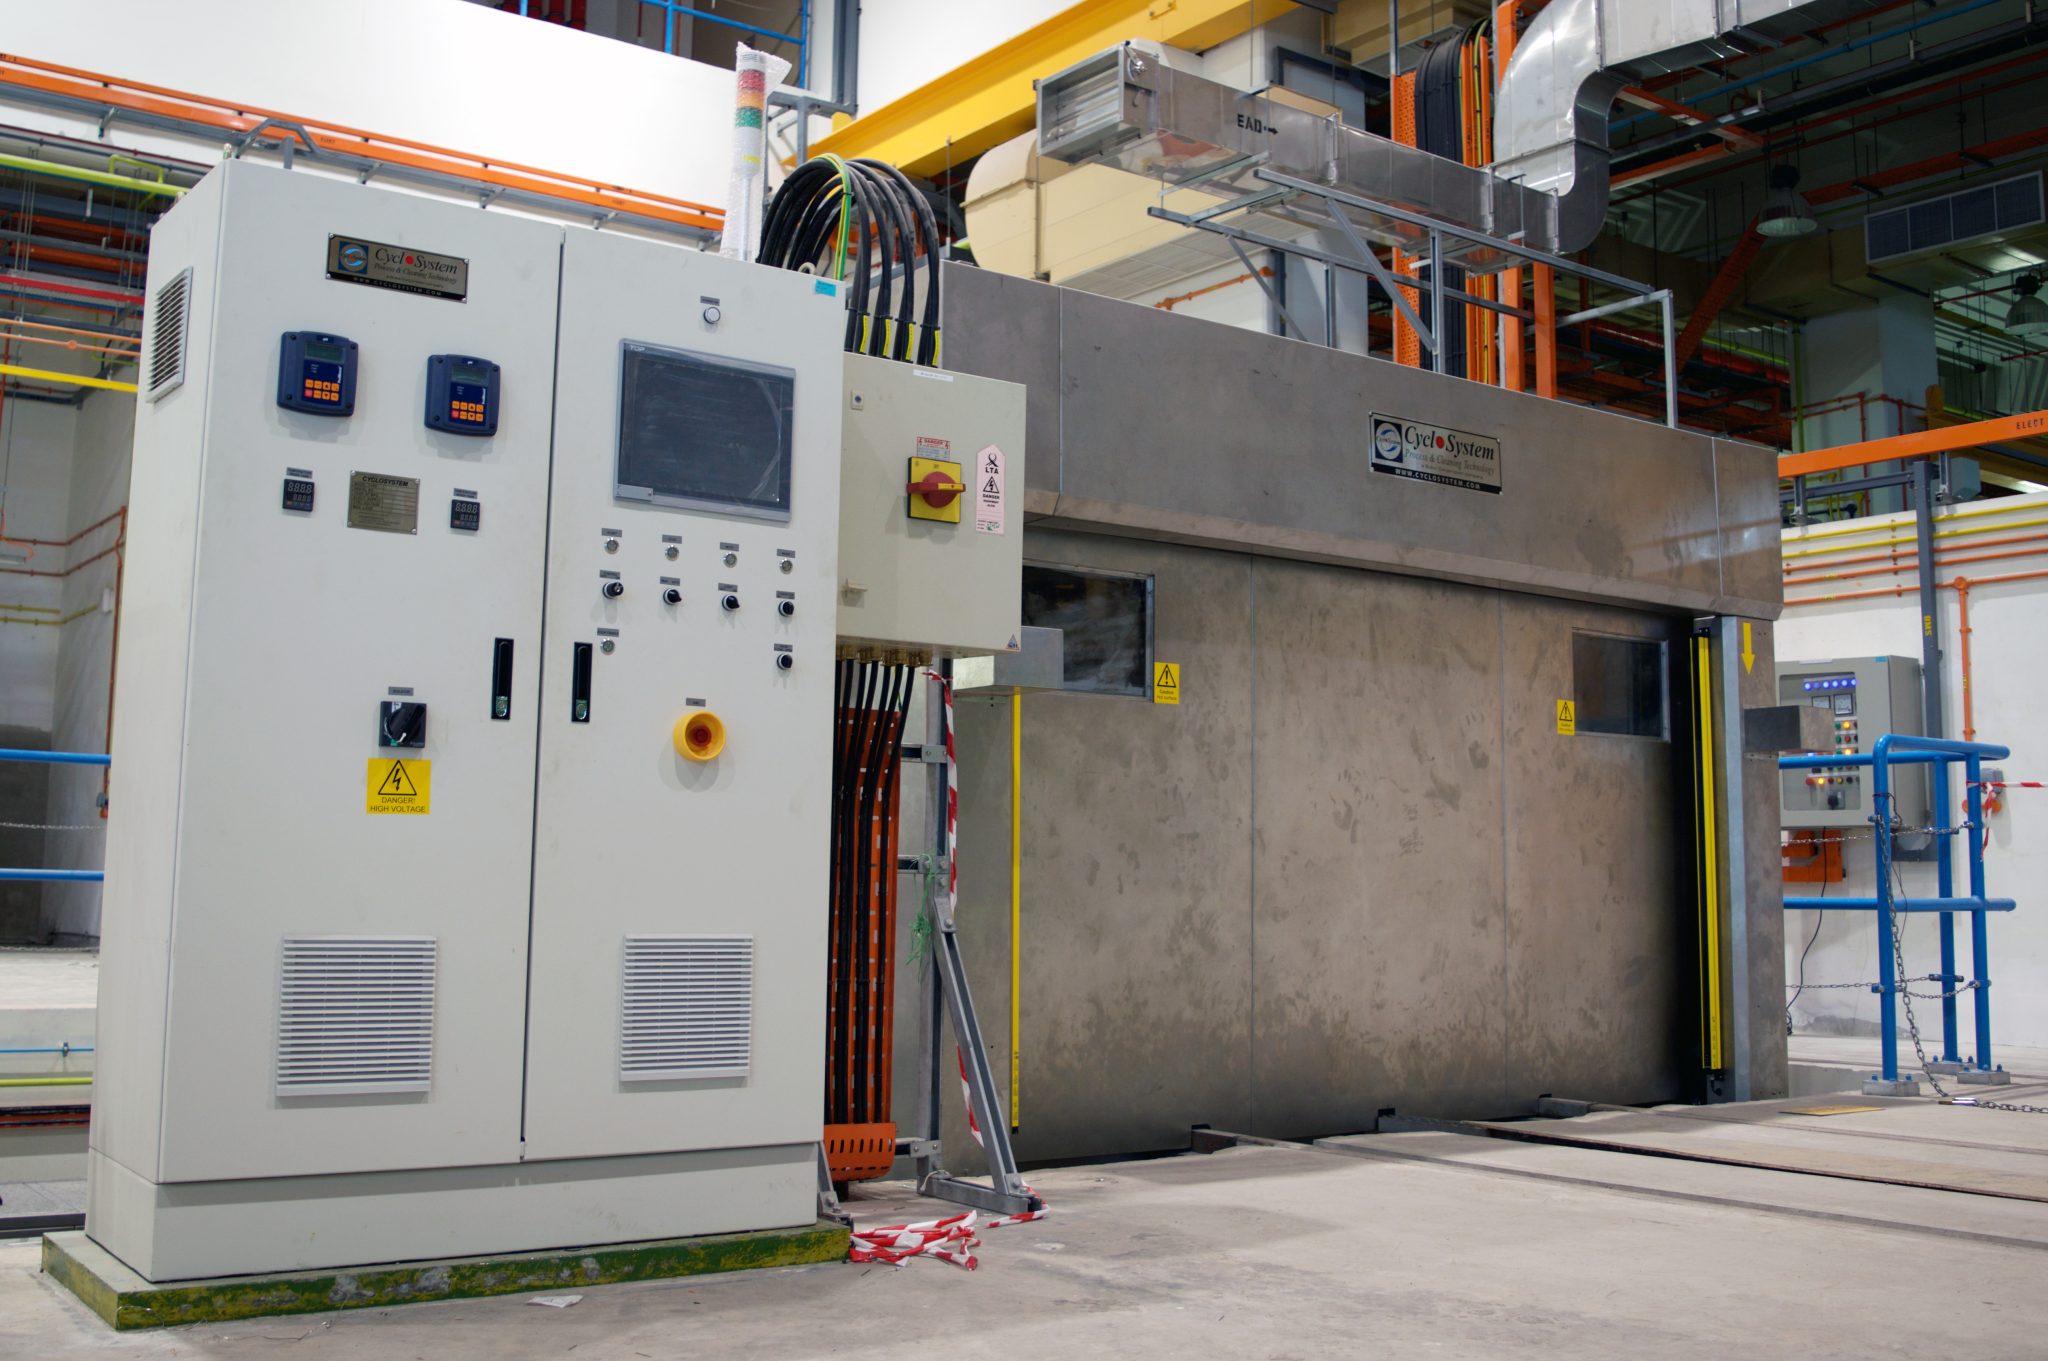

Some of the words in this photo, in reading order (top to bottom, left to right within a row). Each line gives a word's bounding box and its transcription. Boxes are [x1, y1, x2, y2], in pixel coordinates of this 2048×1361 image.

[1237, 114, 1262, 134] EAD
[985, 466, 999, 474] LTA
[1395, 468, 1481, 489] WWW.CYCLOSYSTEM.COM
[381, 796, 416, 804] DANGER!
[370, 805, 389, 813] HIGH
